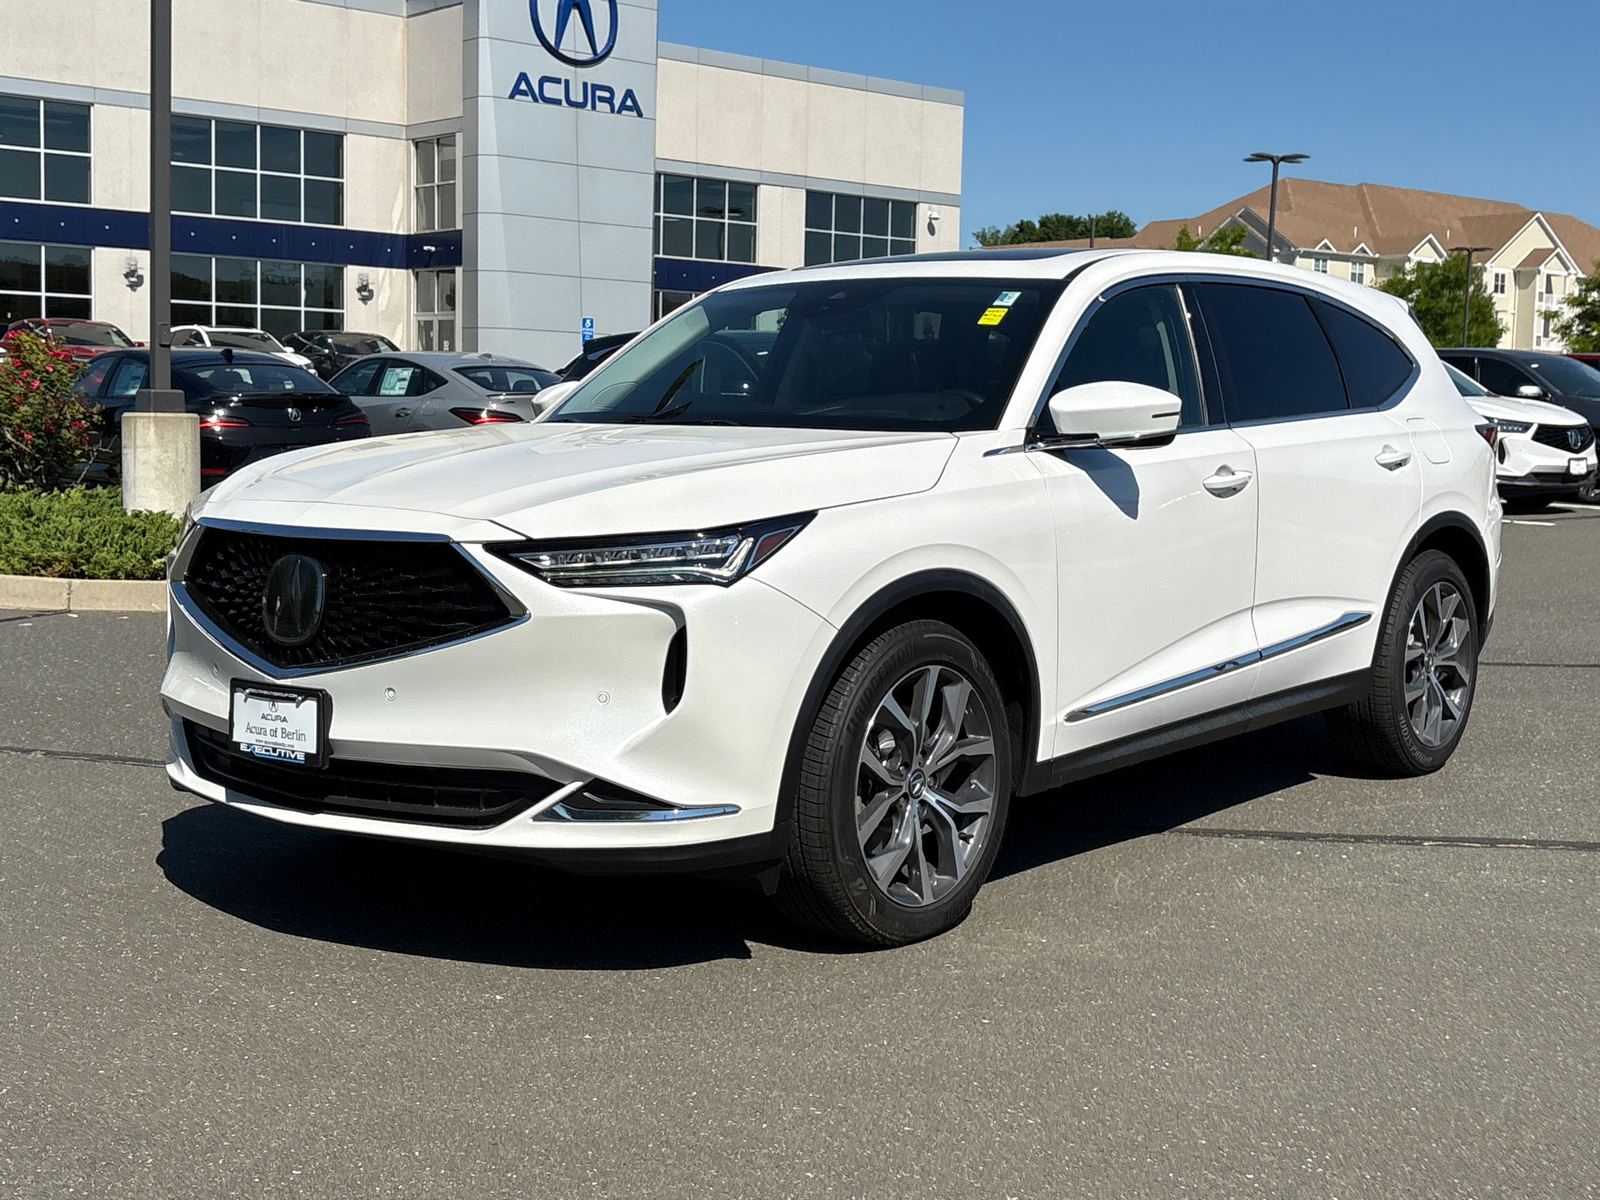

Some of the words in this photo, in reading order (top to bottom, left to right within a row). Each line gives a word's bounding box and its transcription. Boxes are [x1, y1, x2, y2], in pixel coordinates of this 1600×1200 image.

[508, 71, 644, 118] ACURA
[261, 713, 288, 723] ACURA
[246, 722, 267, 737] Acura
[269, 727, 278, 737] of
[282, 728, 306, 742] Berlin
[240, 743, 305, 760] EXECUTIVE
